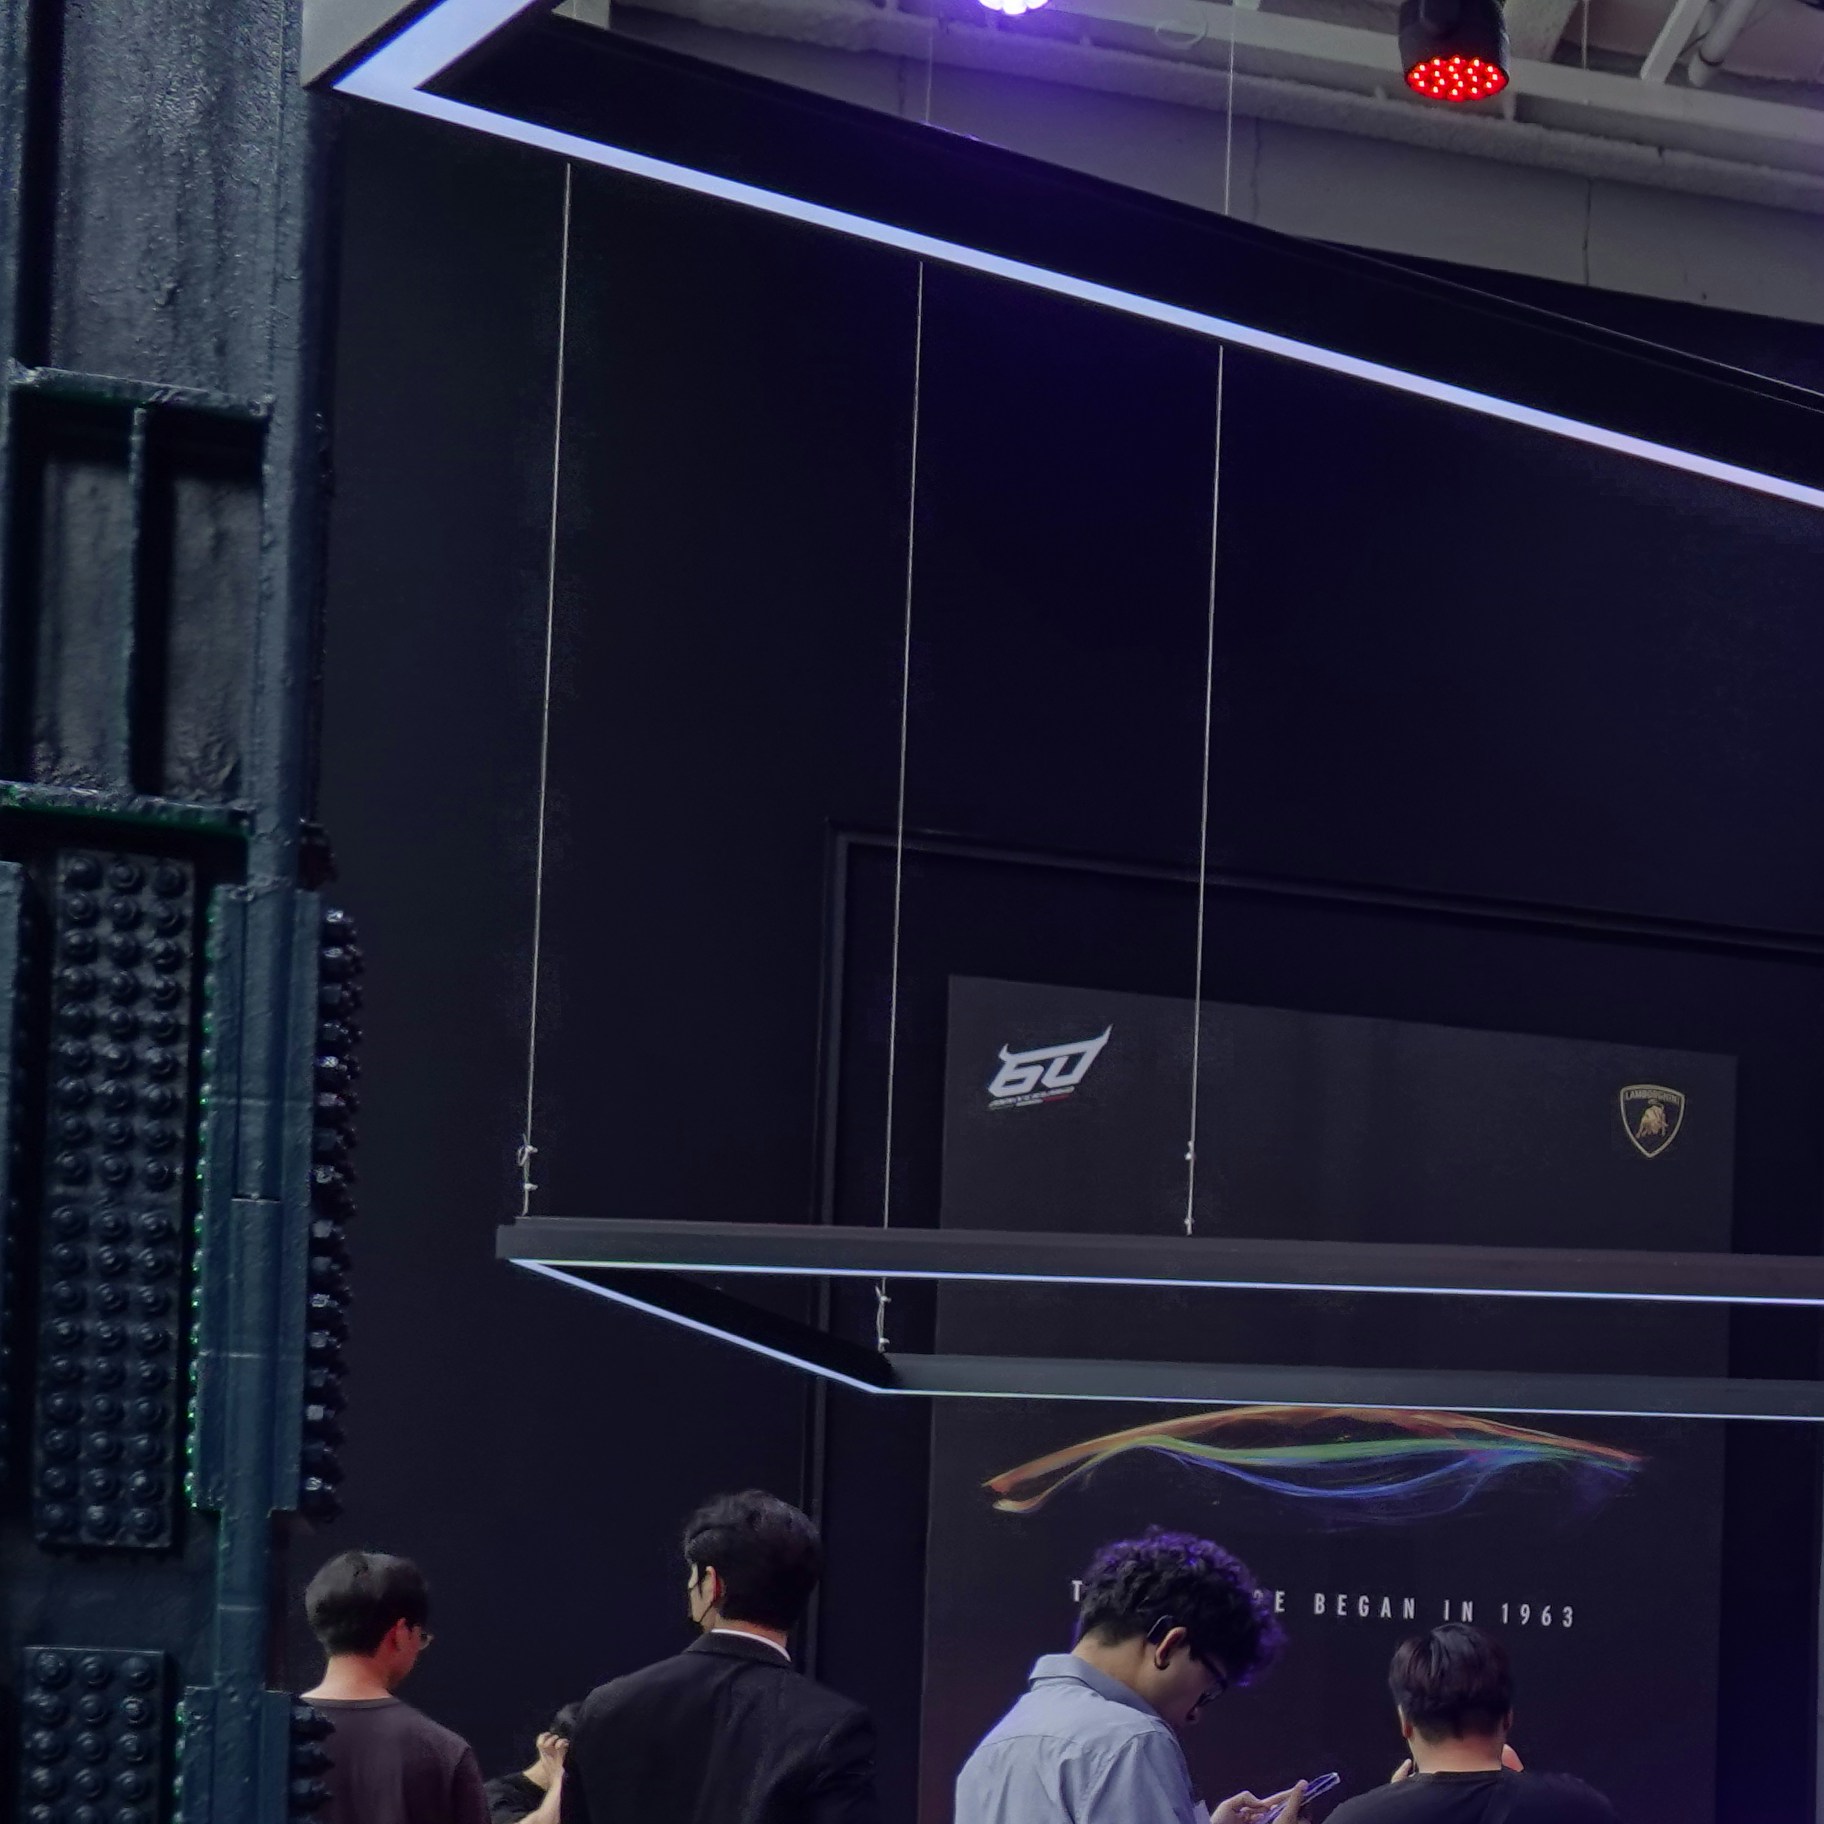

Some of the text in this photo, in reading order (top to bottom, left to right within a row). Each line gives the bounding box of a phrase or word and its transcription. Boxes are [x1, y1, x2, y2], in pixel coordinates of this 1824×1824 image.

[988, 1024, 1114, 1098] 60
[1313, 1592, 1416, 1620] BEGAN
[1444, 1599, 1473, 1622] IN
[1501, 1602, 1574, 1628] 1963
